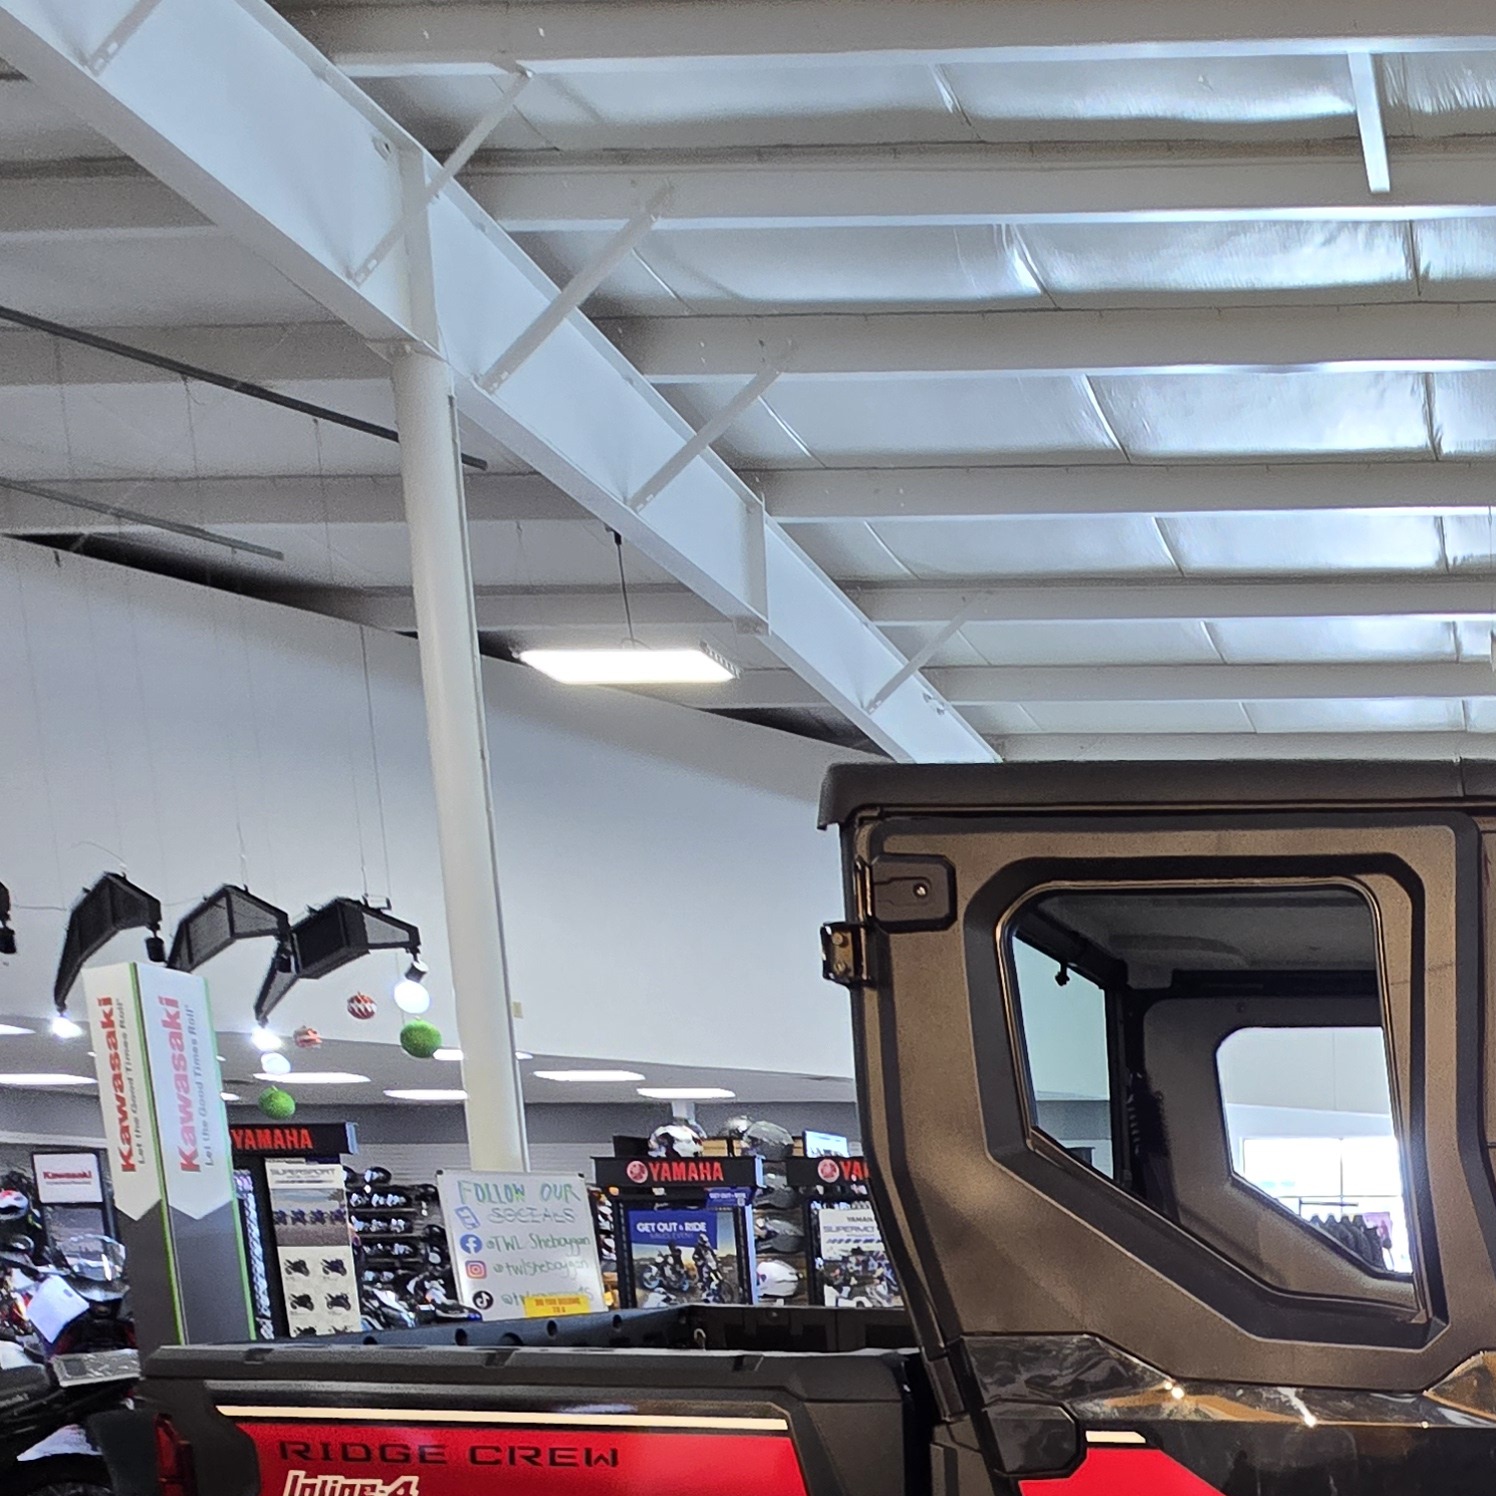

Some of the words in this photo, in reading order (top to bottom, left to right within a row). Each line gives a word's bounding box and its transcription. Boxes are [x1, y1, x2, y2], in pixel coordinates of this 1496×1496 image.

[97, 996, 136, 1172] Kawasaki
[157, 996, 201, 1172] Kawasaki
[231, 1128, 313, 1149] YAMAHA
[43, 1171, 92, 1179] Kawasaki
[649, 1162, 724, 1182] YAMAHA
[458, 1179, 525, 1204] FOLLOW
[540, 1182, 582, 1203] OUR
[487, 1207, 576, 1224] SOCIALS
[636, 1222, 656, 1232] GET
[656, 1222, 677, 1232] OUT
[684, 1222, 707, 1232] RIDE
[279, 1440, 447, 1465] RIDGE
[469, 1445, 619, 1467] CREW
